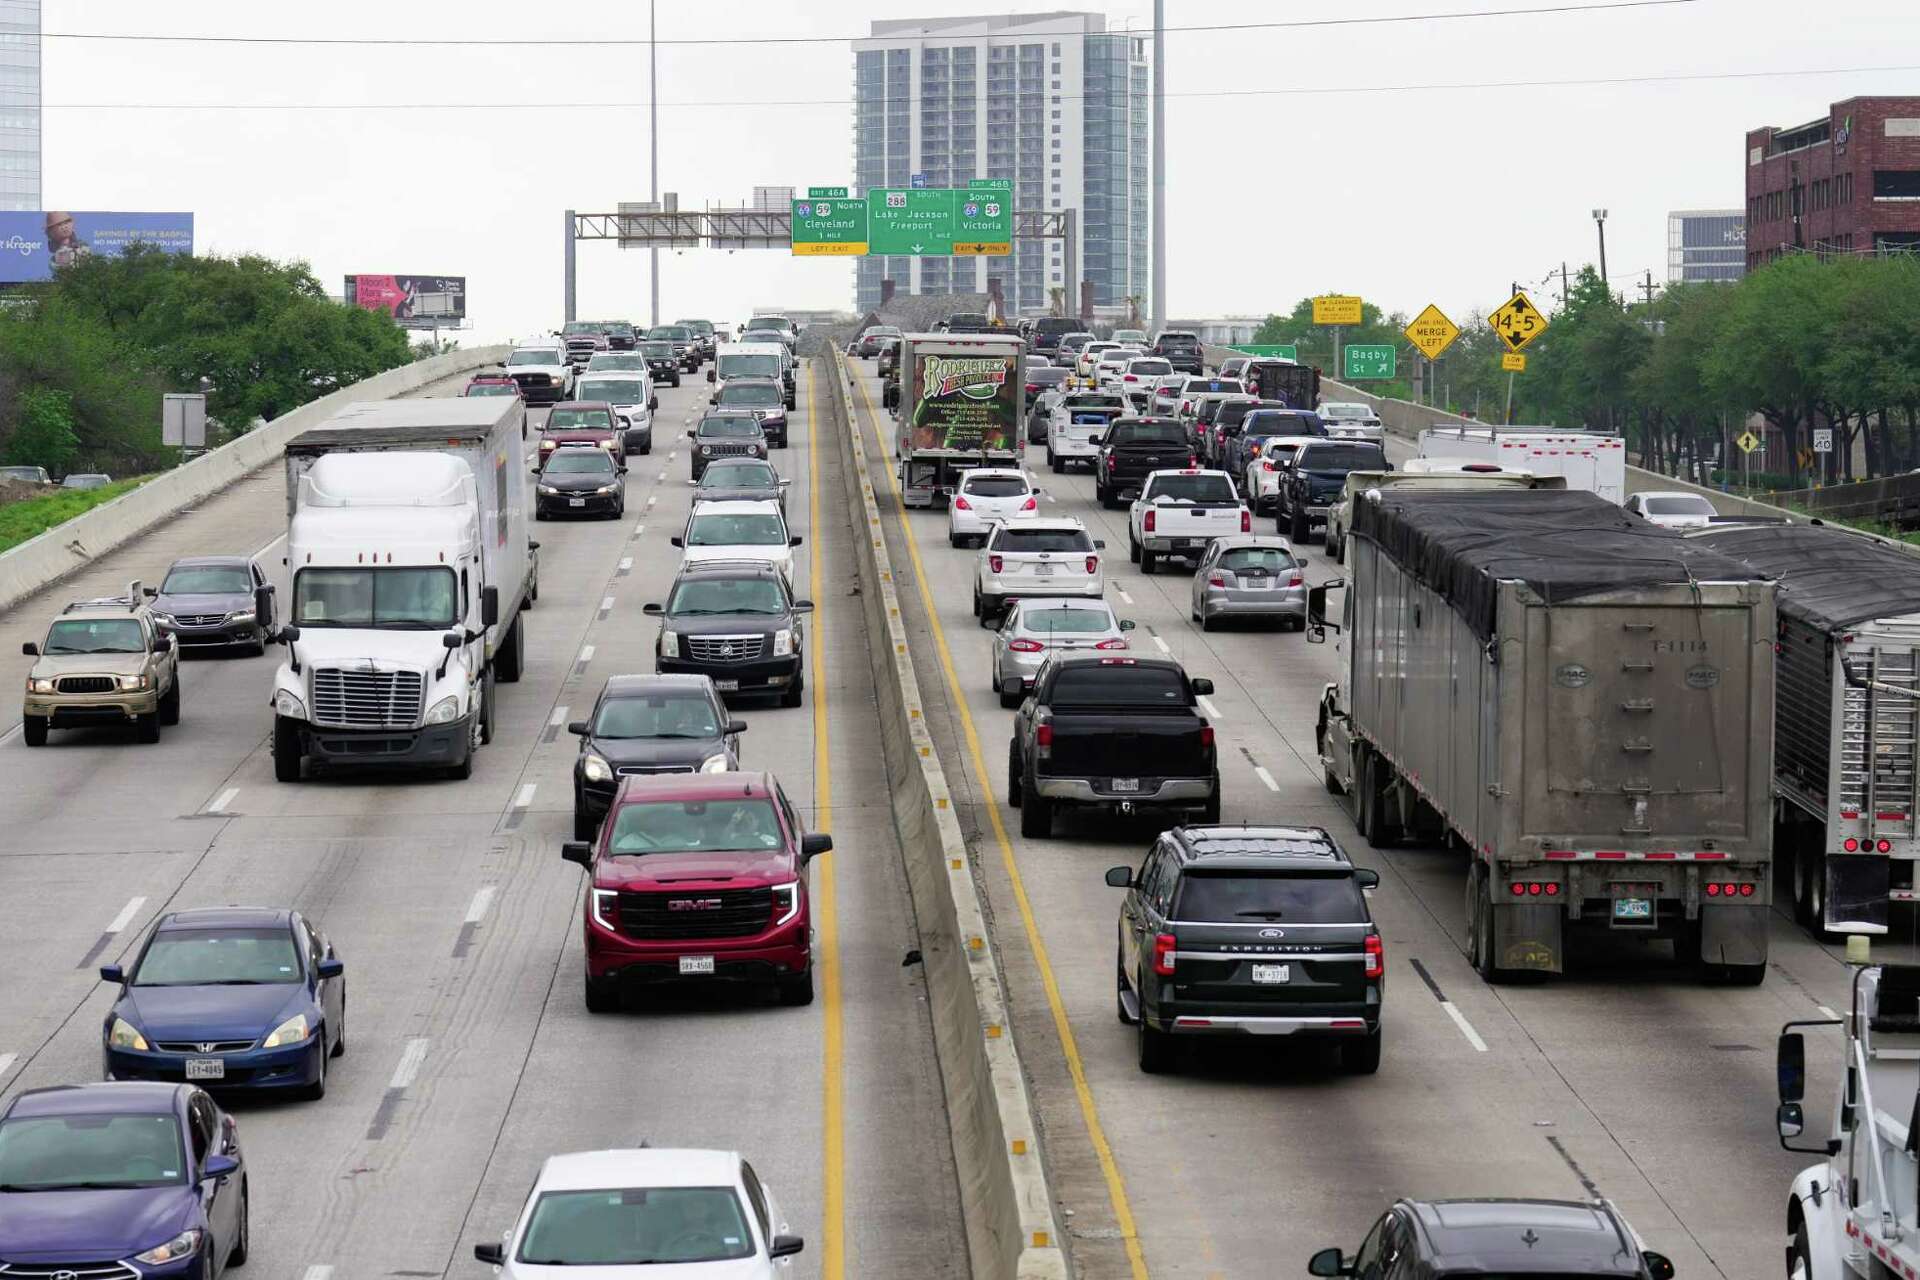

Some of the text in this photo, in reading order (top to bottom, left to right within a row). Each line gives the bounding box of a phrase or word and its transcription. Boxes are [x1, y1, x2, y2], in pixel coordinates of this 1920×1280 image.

[828, 188, 845, 196] 46A
[888, 196, 906, 206] 288
[817, 204, 830, 214] 59
[965, 206, 977, 214] 69
[986, 206, 999, 214] 59
[875, 210, 948, 218] Lake Jackson
[804, 220, 855, 228] Cleveland
[890, 222, 933, 231] Freeport
[962, 221, 1002, 230] Victoria
[6, 235, 42, 256] Kroger
[1416, 328, 1448, 336] MERGE
[1420, 338, 1442, 346] LEFT
[1352, 350, 1388, 360] Bagby
[1352, 364, 1365, 373] St
[1814, 440, 1830, 449] 40
[668, 898, 722, 912] GMC
